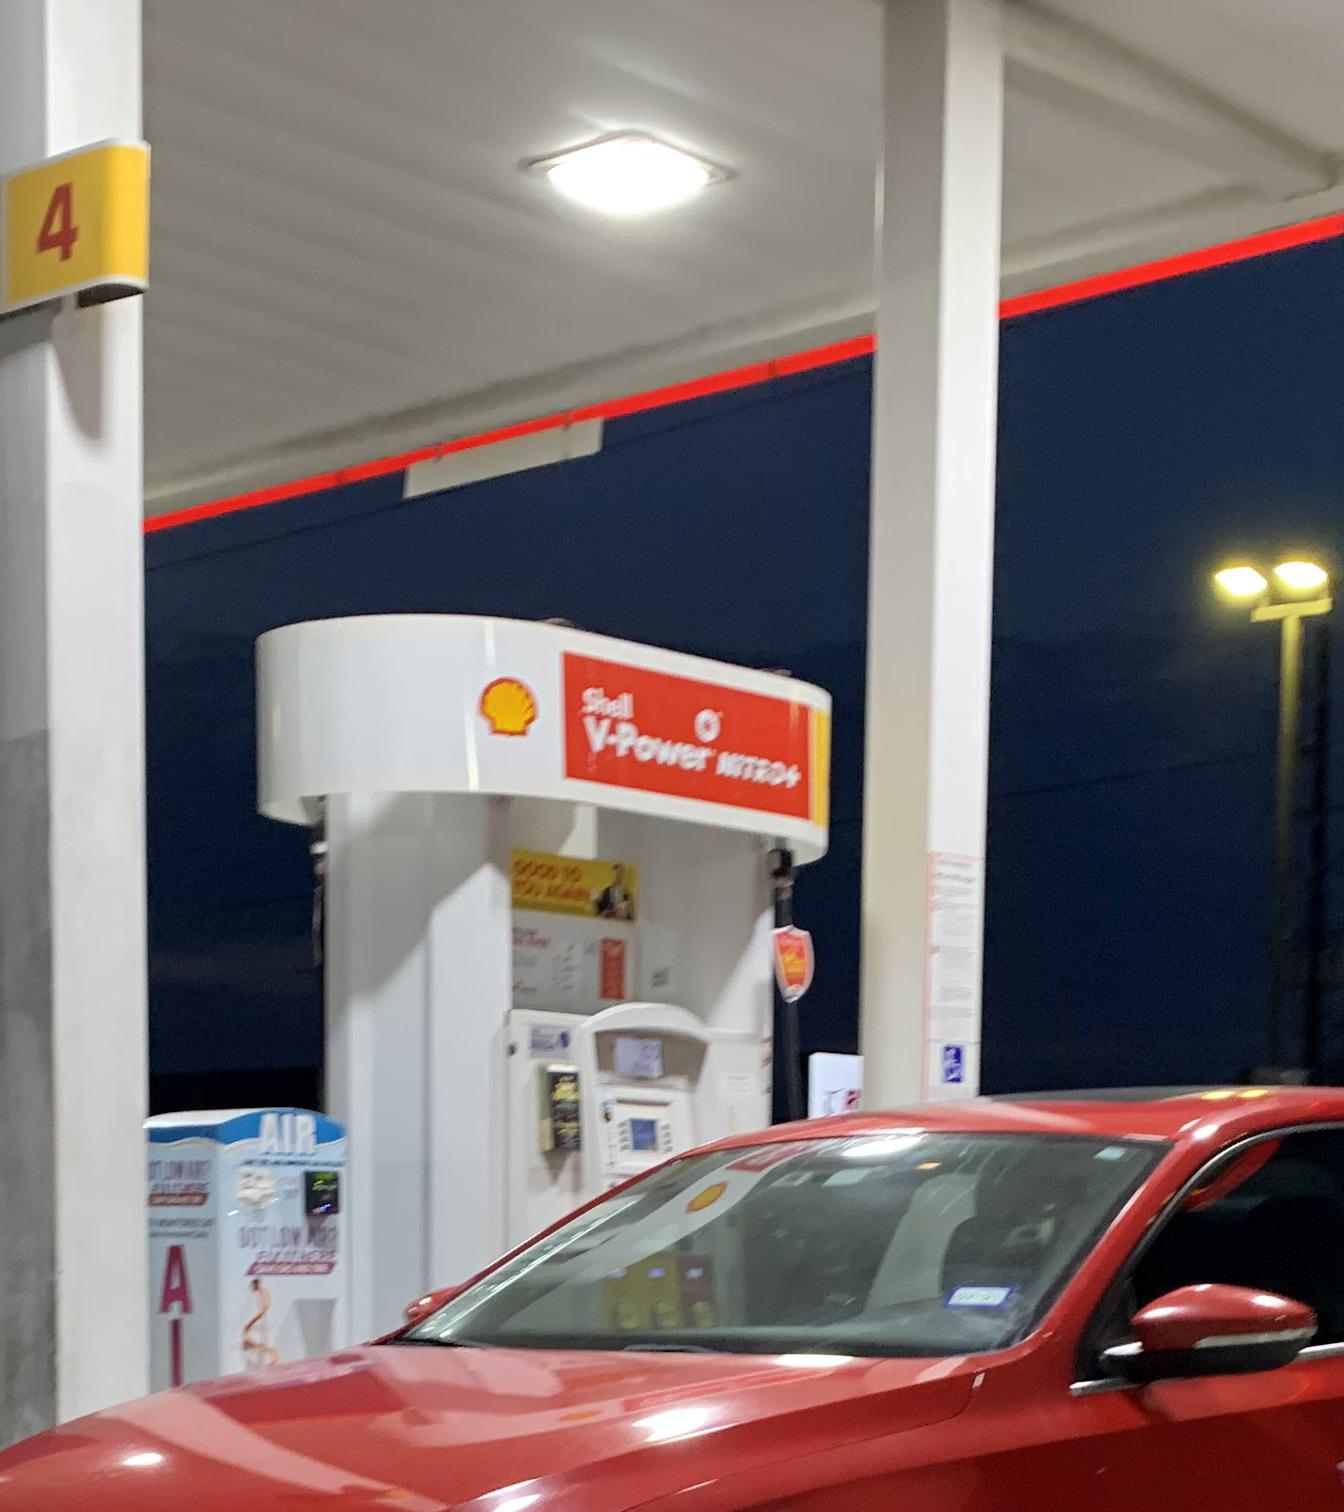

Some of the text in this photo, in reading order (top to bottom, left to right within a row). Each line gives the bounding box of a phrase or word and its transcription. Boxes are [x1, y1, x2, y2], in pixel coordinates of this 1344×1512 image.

[36, 182, 78, 262] 4
[582, 687, 633, 719] Shell
[583, 715, 707, 771] V-Power
[260, 1112, 318, 1153] AIR
